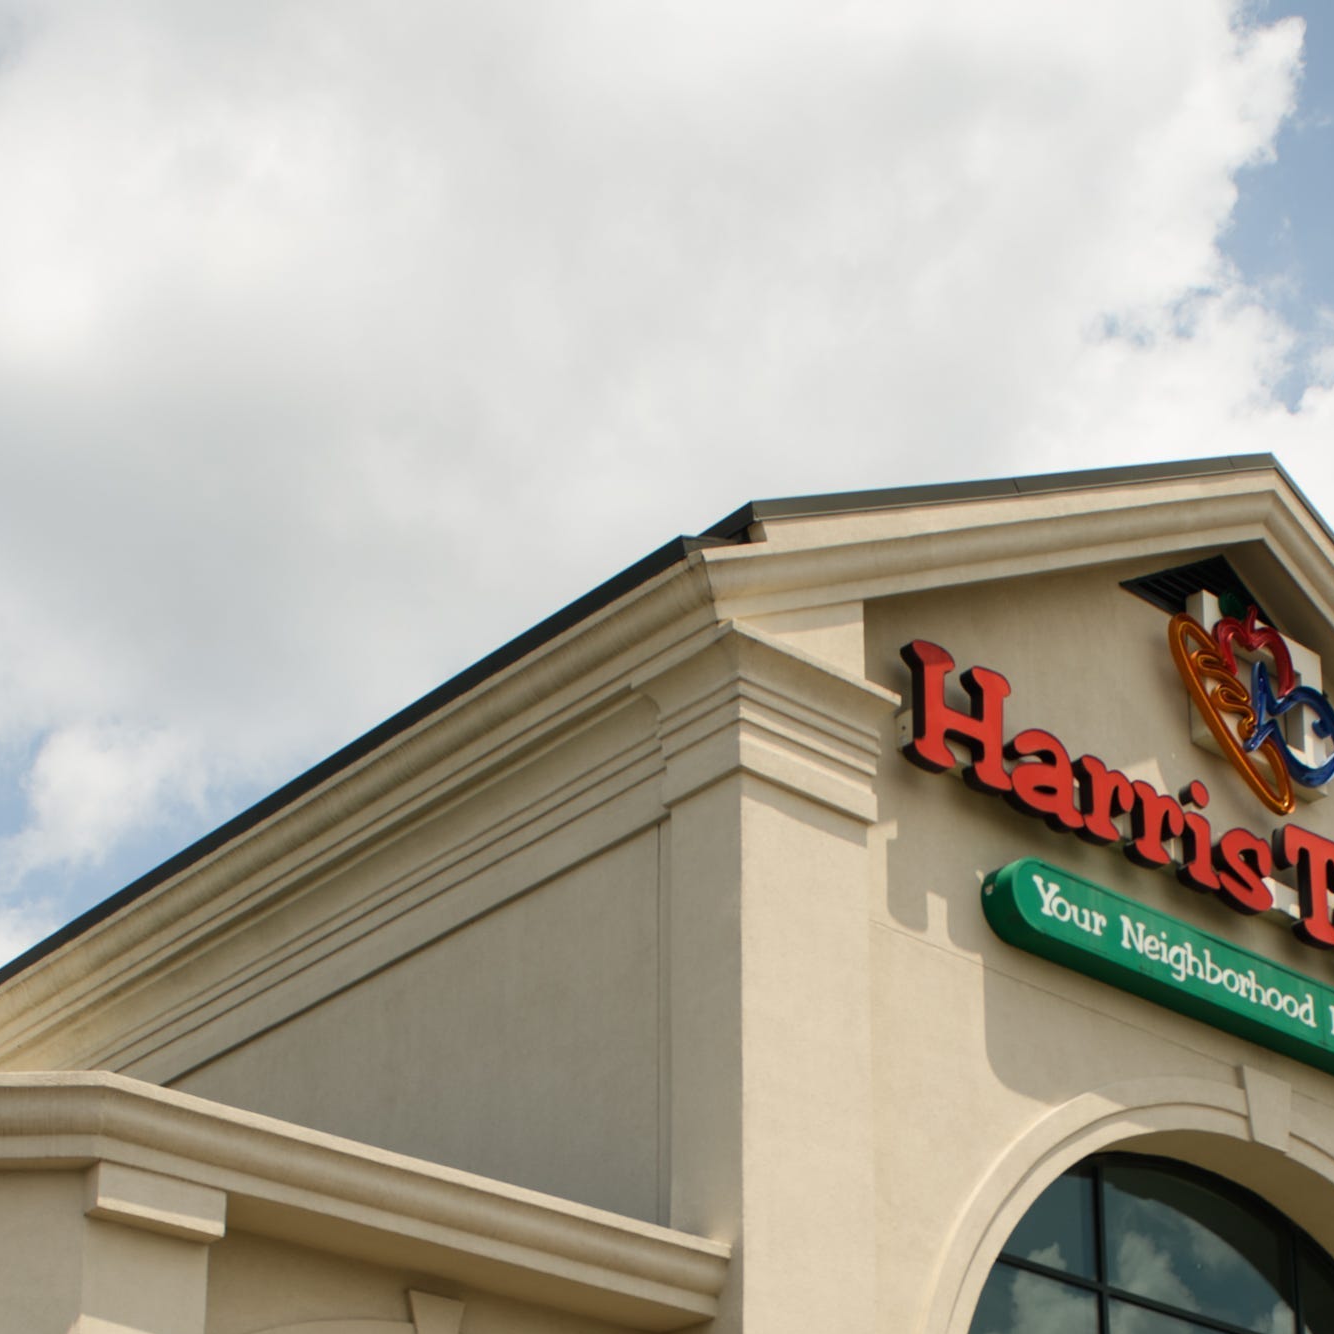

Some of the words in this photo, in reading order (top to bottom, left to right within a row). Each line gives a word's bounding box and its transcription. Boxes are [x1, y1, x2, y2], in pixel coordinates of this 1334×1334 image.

[901, 639, 1273, 915] Harris
[1032, 875, 1107, 937] Your
[1120, 914, 1318, 1029] Neighborhood
